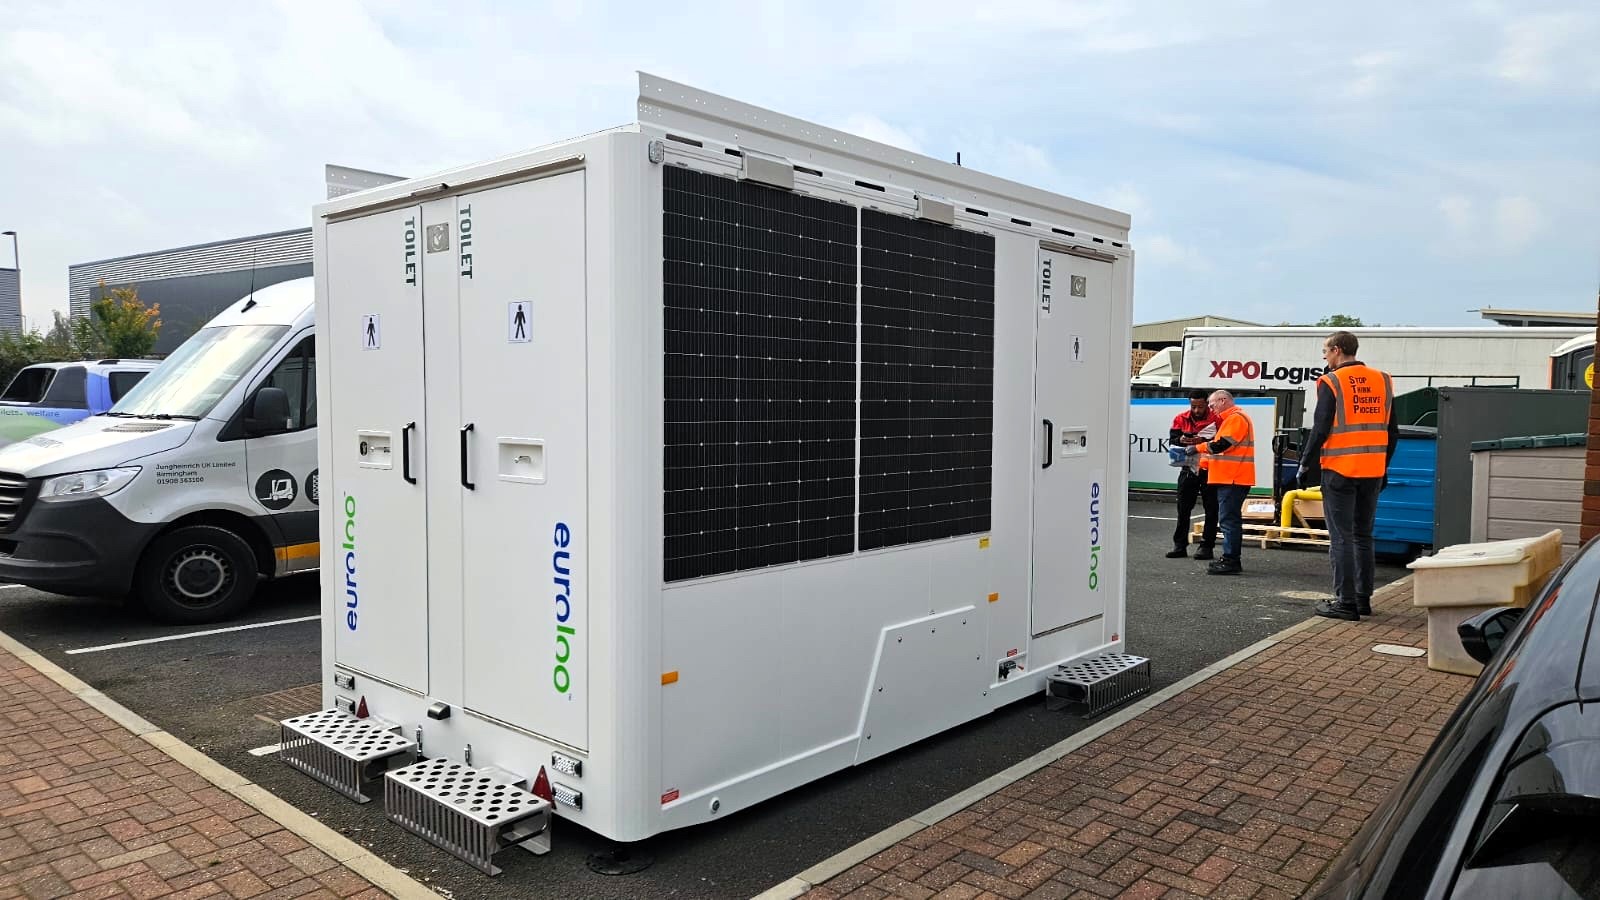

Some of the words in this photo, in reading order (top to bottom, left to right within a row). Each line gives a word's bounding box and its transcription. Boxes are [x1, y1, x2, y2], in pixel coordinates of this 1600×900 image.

[404, 216, 417, 287] TOILET
[459, 203, 473, 280] TOILET
[1042, 258, 1052, 314] TOILET
[342, 495, 358, 631] euroloo
[1088, 482, 1101, 591] euroloo
[553, 521, 576, 694] euroloo
